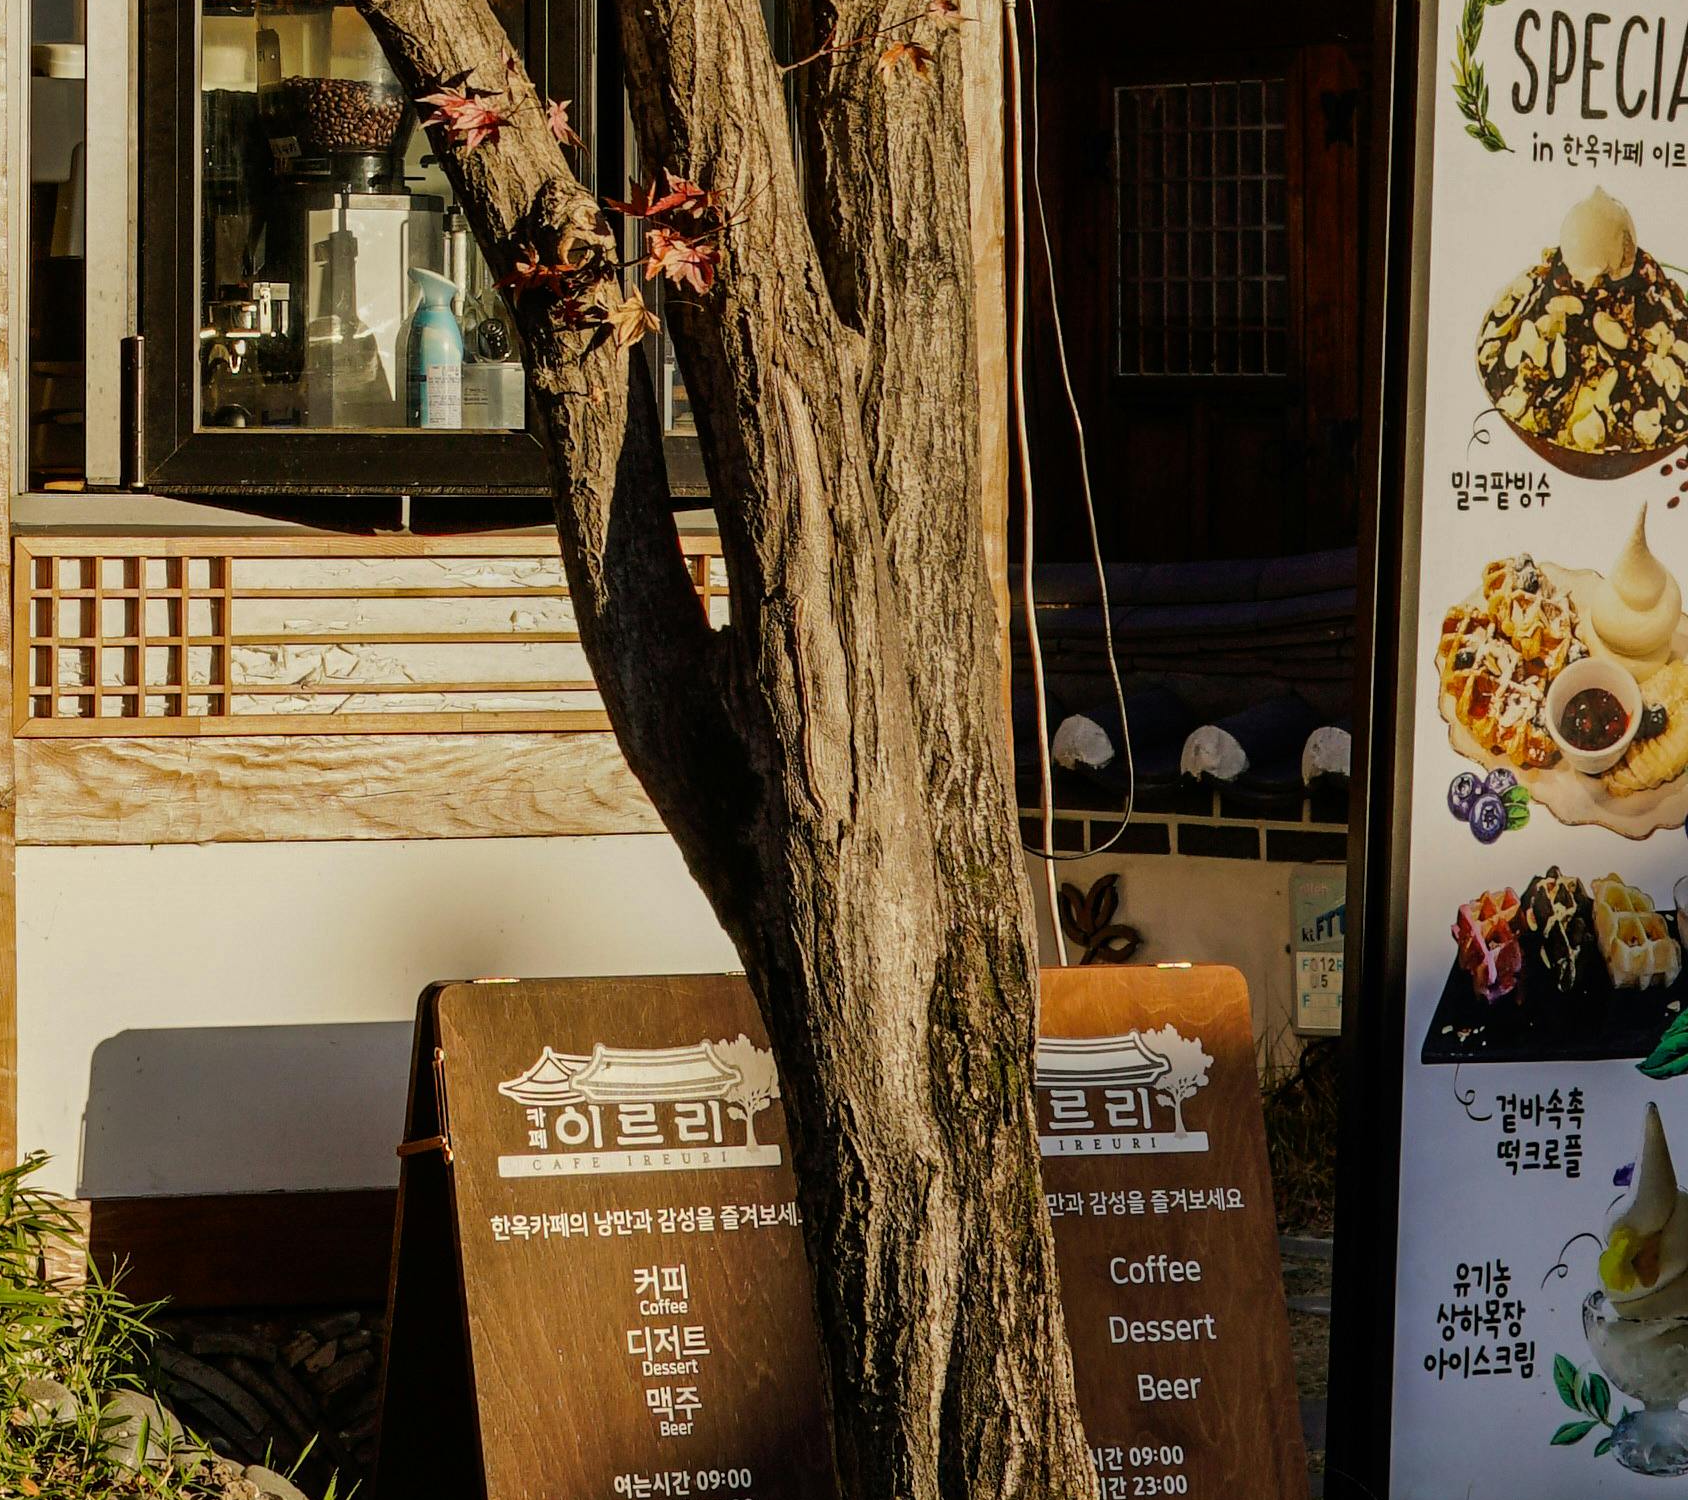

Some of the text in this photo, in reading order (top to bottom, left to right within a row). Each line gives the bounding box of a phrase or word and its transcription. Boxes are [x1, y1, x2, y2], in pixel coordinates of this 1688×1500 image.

[1532, 131, 1554, 162] in
[1563, 133, 1644, 168] 한옥카페
[1451, 470, 1552, 511] 밀크팥빙수
[555, 1100, 724, 1150] 이르리
[1495, 1086, 1585, 1134] 겉바속촉
[525, 1106, 548, 1150] 카페
[1058, 1137, 1157, 1152] IREURI
[530, 1148, 730, 1172] CAFE IREURI
[1496, 1134, 1583, 1179] 떡크로플
[1088, 1190, 1146, 1216] 감성을
[1150, 1187, 1245, 1214] 즐겨보세요
[490, 1201, 803, 1241] 한옥카페의 낭만과 감성을 즐겨보세
[633, 1263, 689, 1300] 커피
[1110, 1254, 1201, 1284] Coffee
[1453, 1258, 1512, 1299] 유기농
[639, 1299, 689, 1316] Coffee
[1436, 1299, 1526, 1342] 상하목장
[626, 1325, 711, 1360] 디저트
[1108, 1313, 1217, 1343] Dessert
[641, 1358, 700, 1377] Dessert
[1423, 1340, 1535, 1381] 아이스크림
[646, 1386, 703, 1421] 맥주
[1137, 1374, 1202, 1402] Beer
[659, 1420, 695, 1437] Beer
[1129, 1445, 1184, 1467] 09:00
[613, 1468, 752, 1500] 여는시간 09:00
[1132, 1474, 1188, 1496] 23:00
